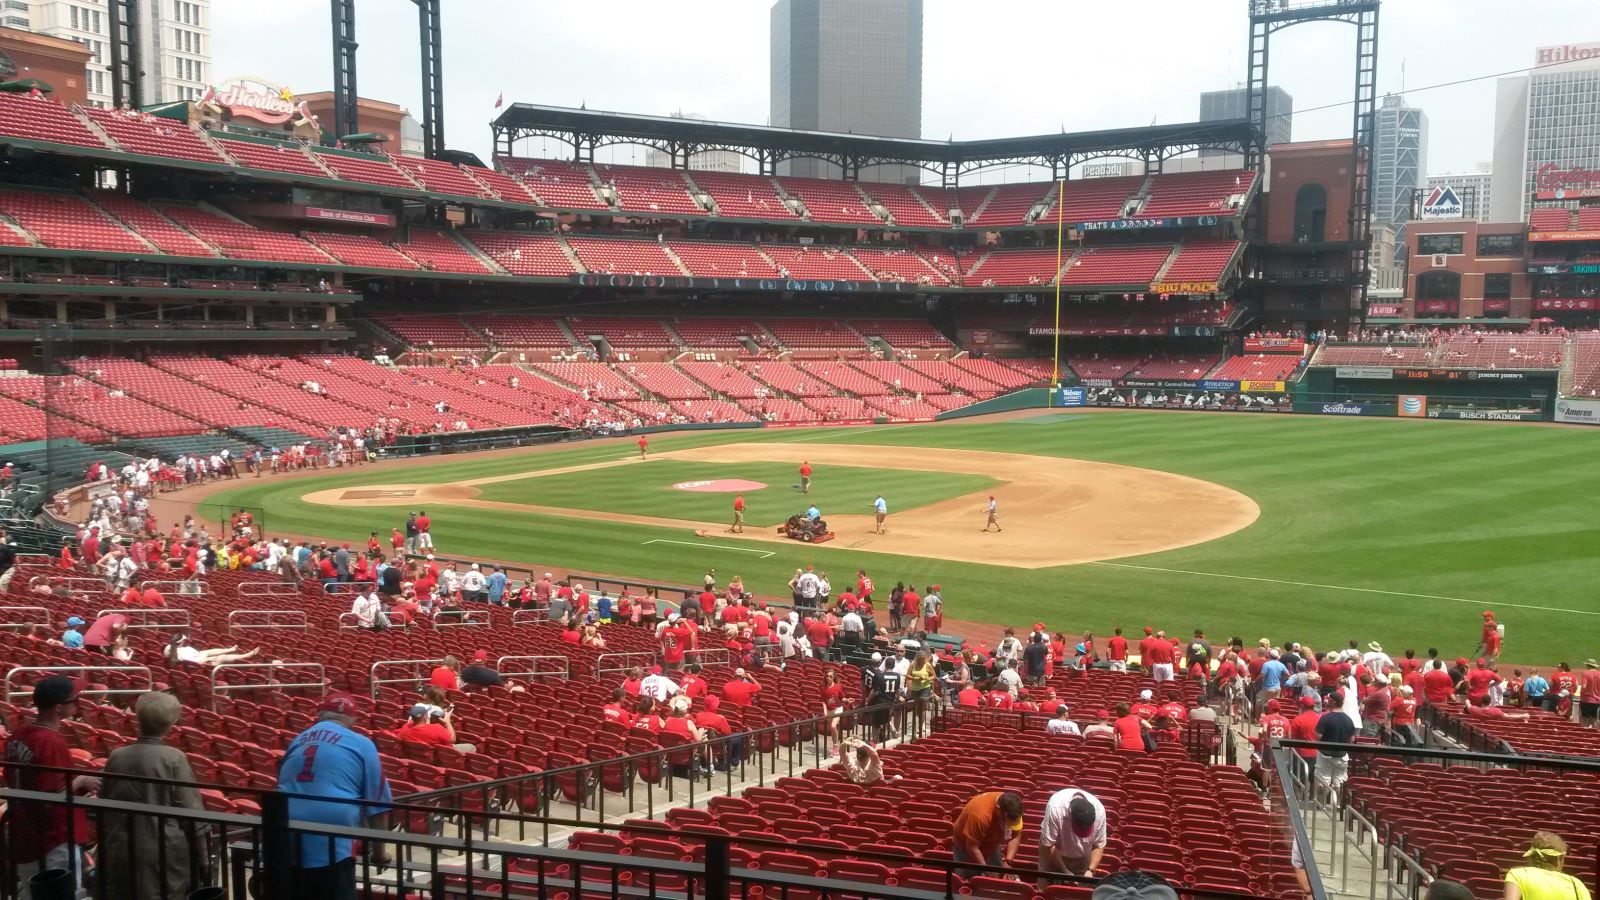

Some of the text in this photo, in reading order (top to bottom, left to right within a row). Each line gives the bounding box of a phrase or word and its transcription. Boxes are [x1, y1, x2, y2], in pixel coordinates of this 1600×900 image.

[1084, 163, 1121, 176] Peabody
[1423, 203, 1461, 216] Majestic
[1084, 221, 1107, 230] THAT'S
[1111, 221, 1116, 229] A
[1573, 265, 1597, 273] TAKING
[1158, 282, 1209, 293] BIG MAC
[1322, 404, 1362, 414] Scottrade
[1460, 411, 1520, 420] BUSCH STADIUM
[644, 685, 660, 697] 32
[681, 684, 689, 693] 4
[884, 679, 896, 693] 11
[994, 697, 1002, 707] 7
[300, 729, 342, 745] SMITH
[1270, 726, 1285, 738] 23
[295, 744, 319, 783] 1
